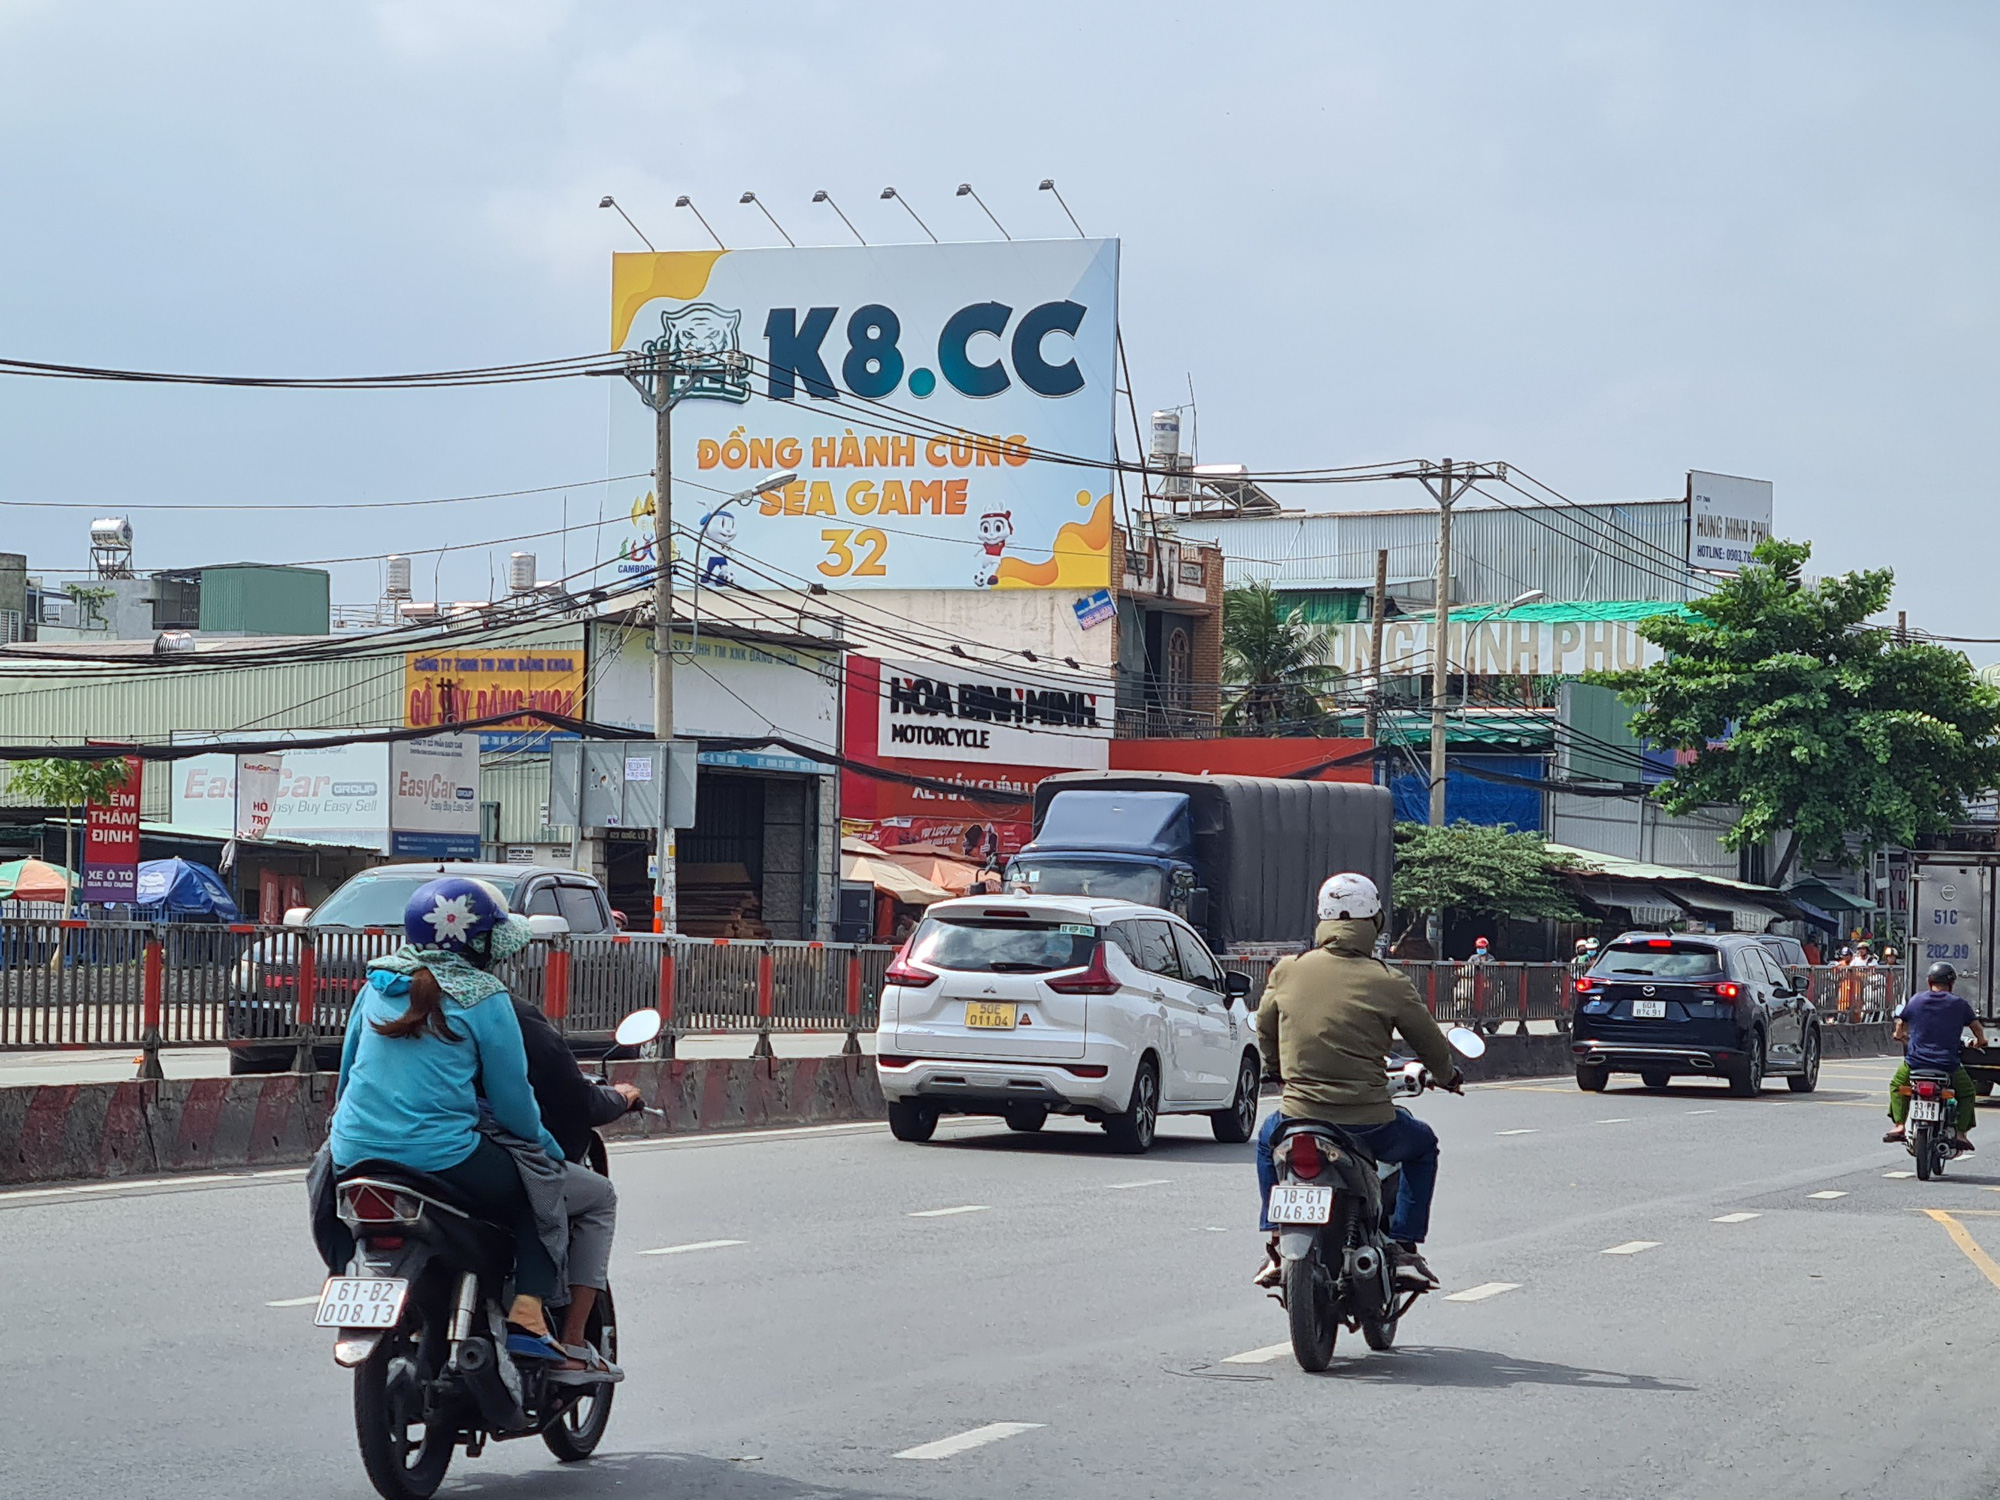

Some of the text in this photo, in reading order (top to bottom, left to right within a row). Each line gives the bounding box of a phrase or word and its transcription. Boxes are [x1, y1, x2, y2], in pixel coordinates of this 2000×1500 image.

[763, 299, 1088, 400] K8.CC
[697, 426, 1030, 469] ĐỒNG HÀNH CÙNG
[759, 478, 968, 516] SEA GAME
[1725, 517, 1748, 542] MINH
[817, 528, 887, 576] 32
[1697, 545, 1725, 560] HOTLINE:
[1318, 623, 1414, 675] UNG
[1427, 622, 1539, 674] MINH
[892, 724, 990, 749] MOTORCYCLE
[334, 784, 377, 795] GROUP
[398, 771, 456, 805] EasyCar
[298, 801, 320, 813] Buy
[324, 801, 350, 813] Easy
[355, 799, 378, 811] Sell
[91, 829, 133, 844] ĐỊNH
[88, 870, 103, 880] XE
[107, 869, 116, 881] Ô
[1934, 909, 1958, 925] 51C
[1927, 943, 1969, 959] 202.89
[980, 1004, 1002, 1015] 50E
[970, 1015, 1008, 1027] 011.04
[1283, 1190, 1322, 1204] 18-G1
[1273, 1205, 1326, 1221] 046.33
[338, 1282, 394, 1301] 61-B2
[323, 1304, 395, 1324] 008.13
